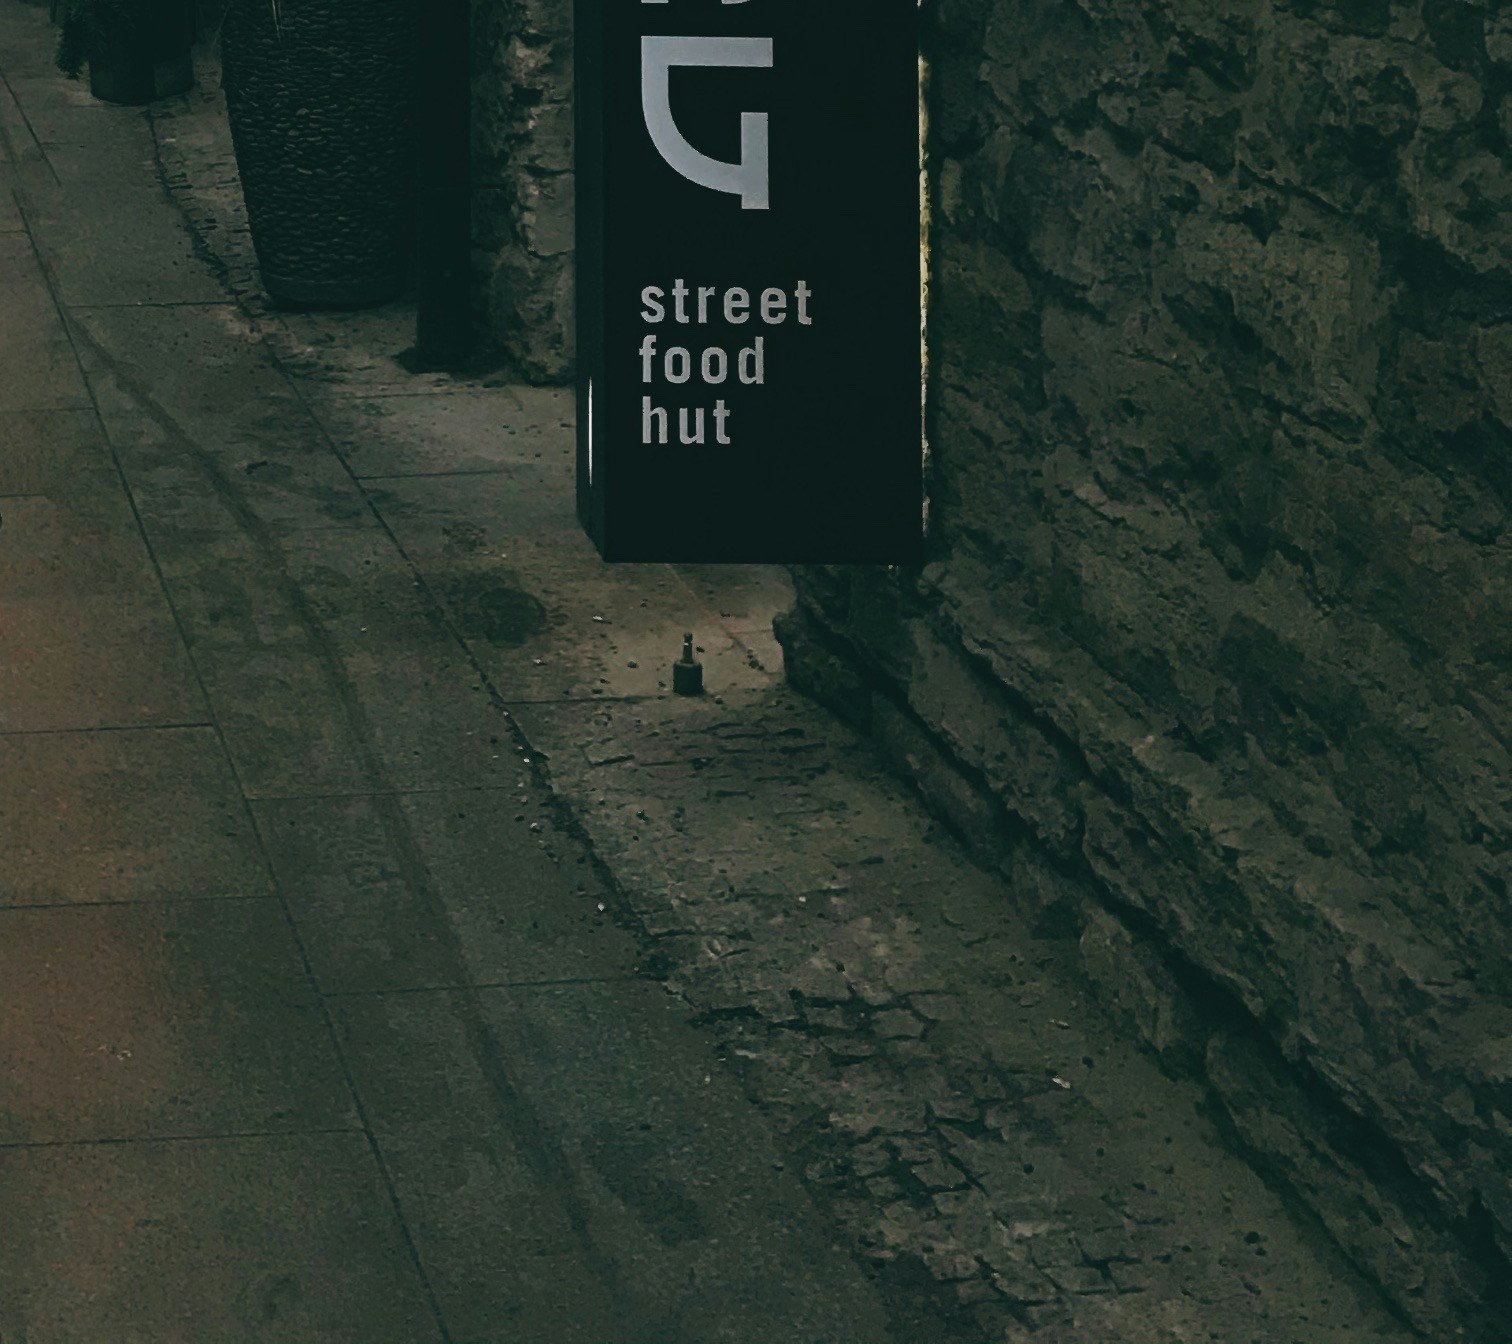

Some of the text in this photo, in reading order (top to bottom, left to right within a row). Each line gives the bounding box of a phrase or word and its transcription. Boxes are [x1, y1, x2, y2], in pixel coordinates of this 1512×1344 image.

[640, 278, 812, 326] street
[638, 334, 765, 385] food
[642, 395, 731, 445] hut
